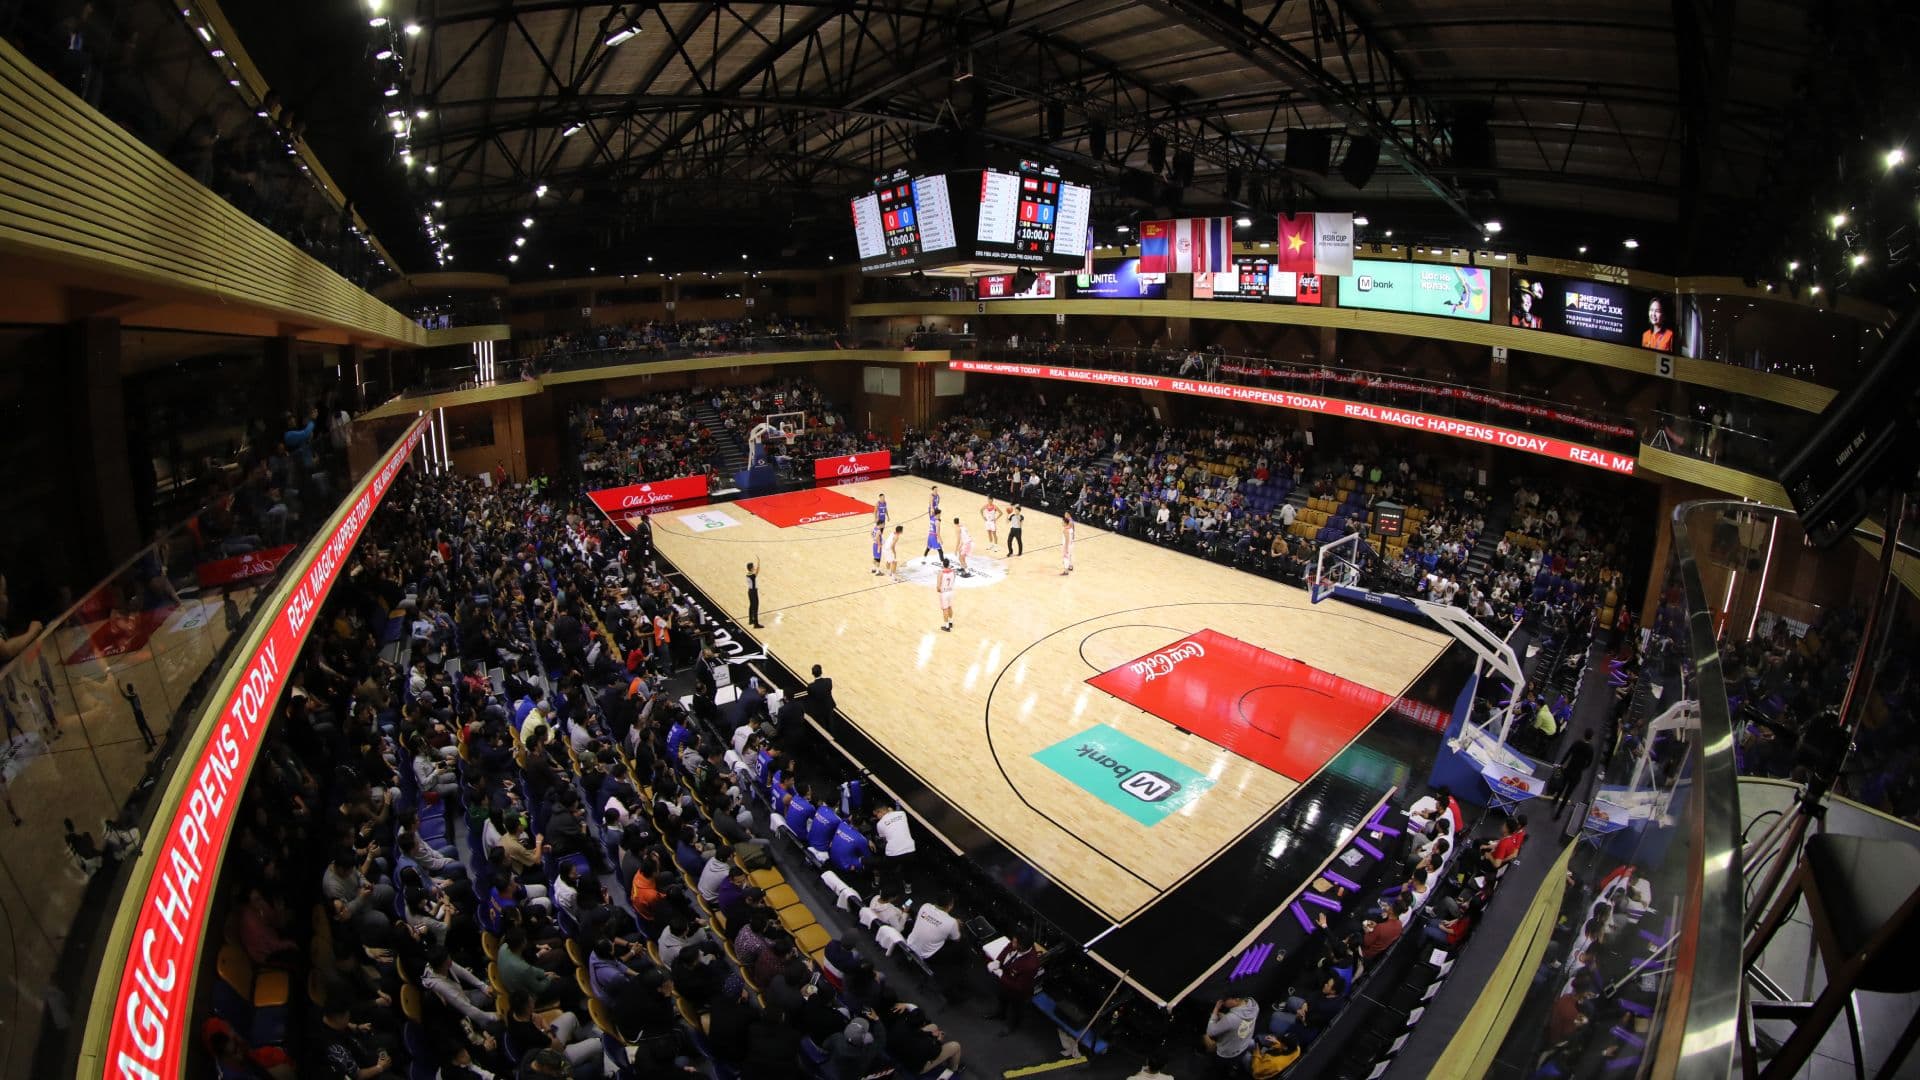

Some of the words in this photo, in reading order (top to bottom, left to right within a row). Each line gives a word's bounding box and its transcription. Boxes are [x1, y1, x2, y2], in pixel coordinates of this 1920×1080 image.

[888, 215, 895, 227] 0
[903, 211, 909, 223] 0
[1026, 205, 1033, 219] 0
[1043, 207, 1049, 220] 0
[891, 232, 915, 247] 10:00.0
[1022, 228, 1049, 241] 10:00.0
[1090, 273, 1118, 284] UNITEL
[1373, 280, 1394, 289] bank
[1579, 294, 1610, 305] ЭНЕРЖИ
[1579, 302, 1607, 312] РЕСУРС
[978, 303, 984, 313] 6
[1020, 366, 1040, 374] TODAY
[1660, 357, 1670, 375] 5
[1068, 370, 1091, 379] MAGIC
[1093, 373, 1128, 383] HAPPENS
[1131, 376, 1159, 387] TODAY
[1172, 381, 1195, 392] REAL
[1198, 383, 1230, 396] MAGIC
[1234, 388, 1283, 404] HAPPENS
[1287, 395, 1327, 410] TODAY
[1345, 404, 1377, 419] REAL
[1381, 410, 1424, 427] MAGIC
[1428, 418, 1493, 440] HAPPENS
[1497, 431, 1548, 451] TODAY
[1569, 447, 1608, 466] REAL
[837, 464, 851, 475] Old
[851, 463, 870, 475] Spice
[622, 495, 644, 508] Old
[643, 491, 673, 505] Spice
[287, 586, 314, 638] REAL
[310, 545, 335, 598] MAGIC
[332, 510, 358, 561] HAPPENS
[356, 491, 371, 523] TODAY
[1074, 744, 1132, 779] bank
[155, 724, 241, 944] HAPPENS
[232, 637, 279, 740] TODAY
